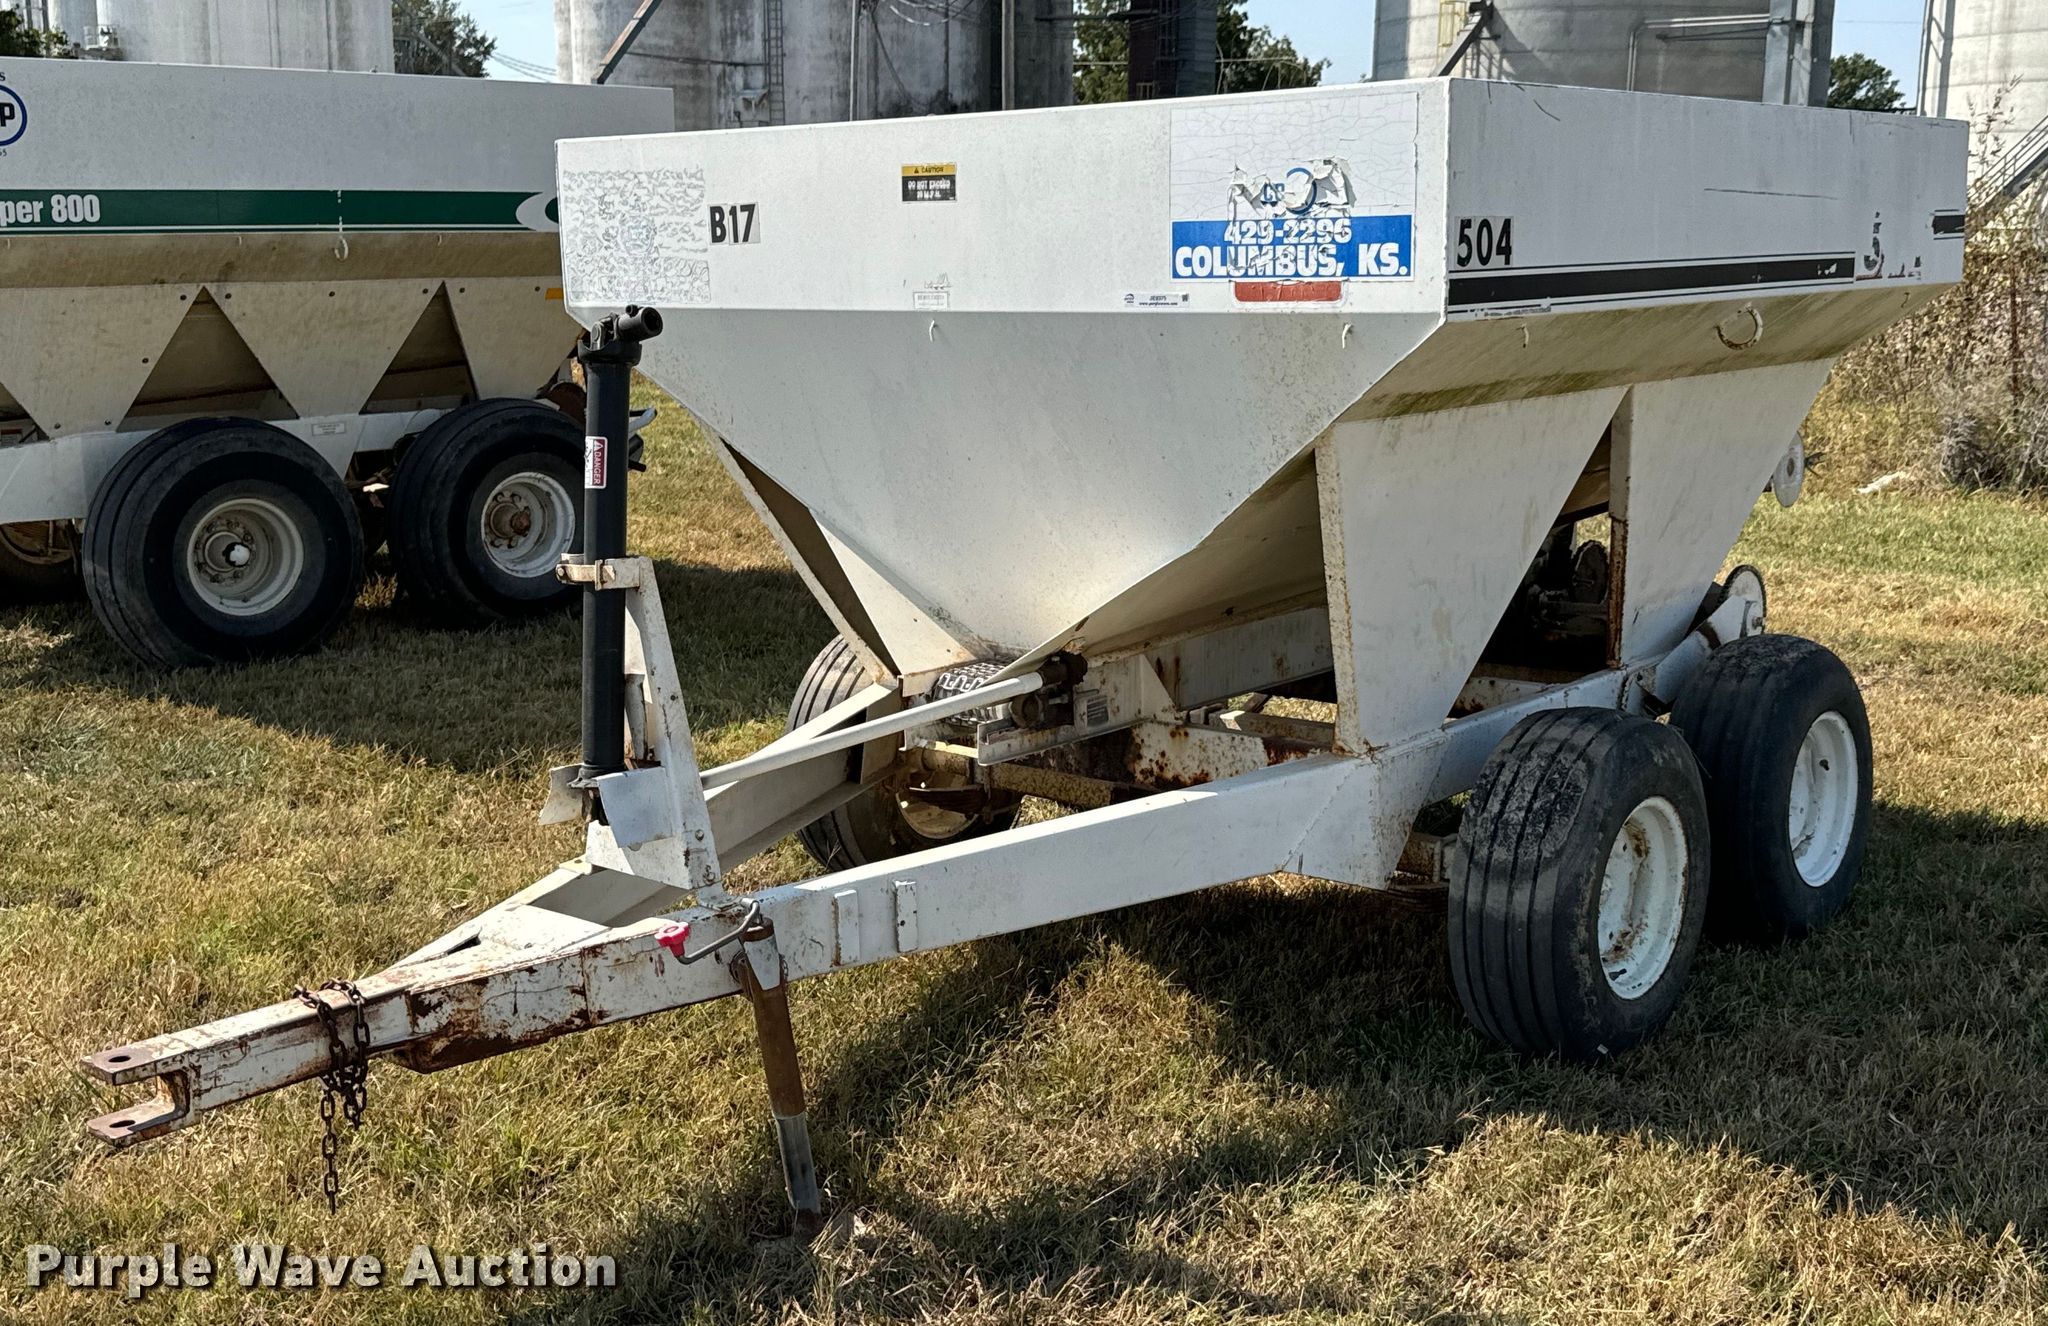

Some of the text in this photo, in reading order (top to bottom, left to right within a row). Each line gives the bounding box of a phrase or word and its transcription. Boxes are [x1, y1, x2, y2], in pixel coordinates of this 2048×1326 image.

[907, 180, 916, 190] DO
[916, 180, 928, 190] NOT
[50, 194, 100, 223] 800
[709, 203, 755, 243] B17
[1224, 218, 1352, 245] 429-2296
[1456, 218, 1512, 267] 504
[1175, 243, 1408, 277] COLUMBUS, KS.
[593, 451, 602, 485] DANGER
